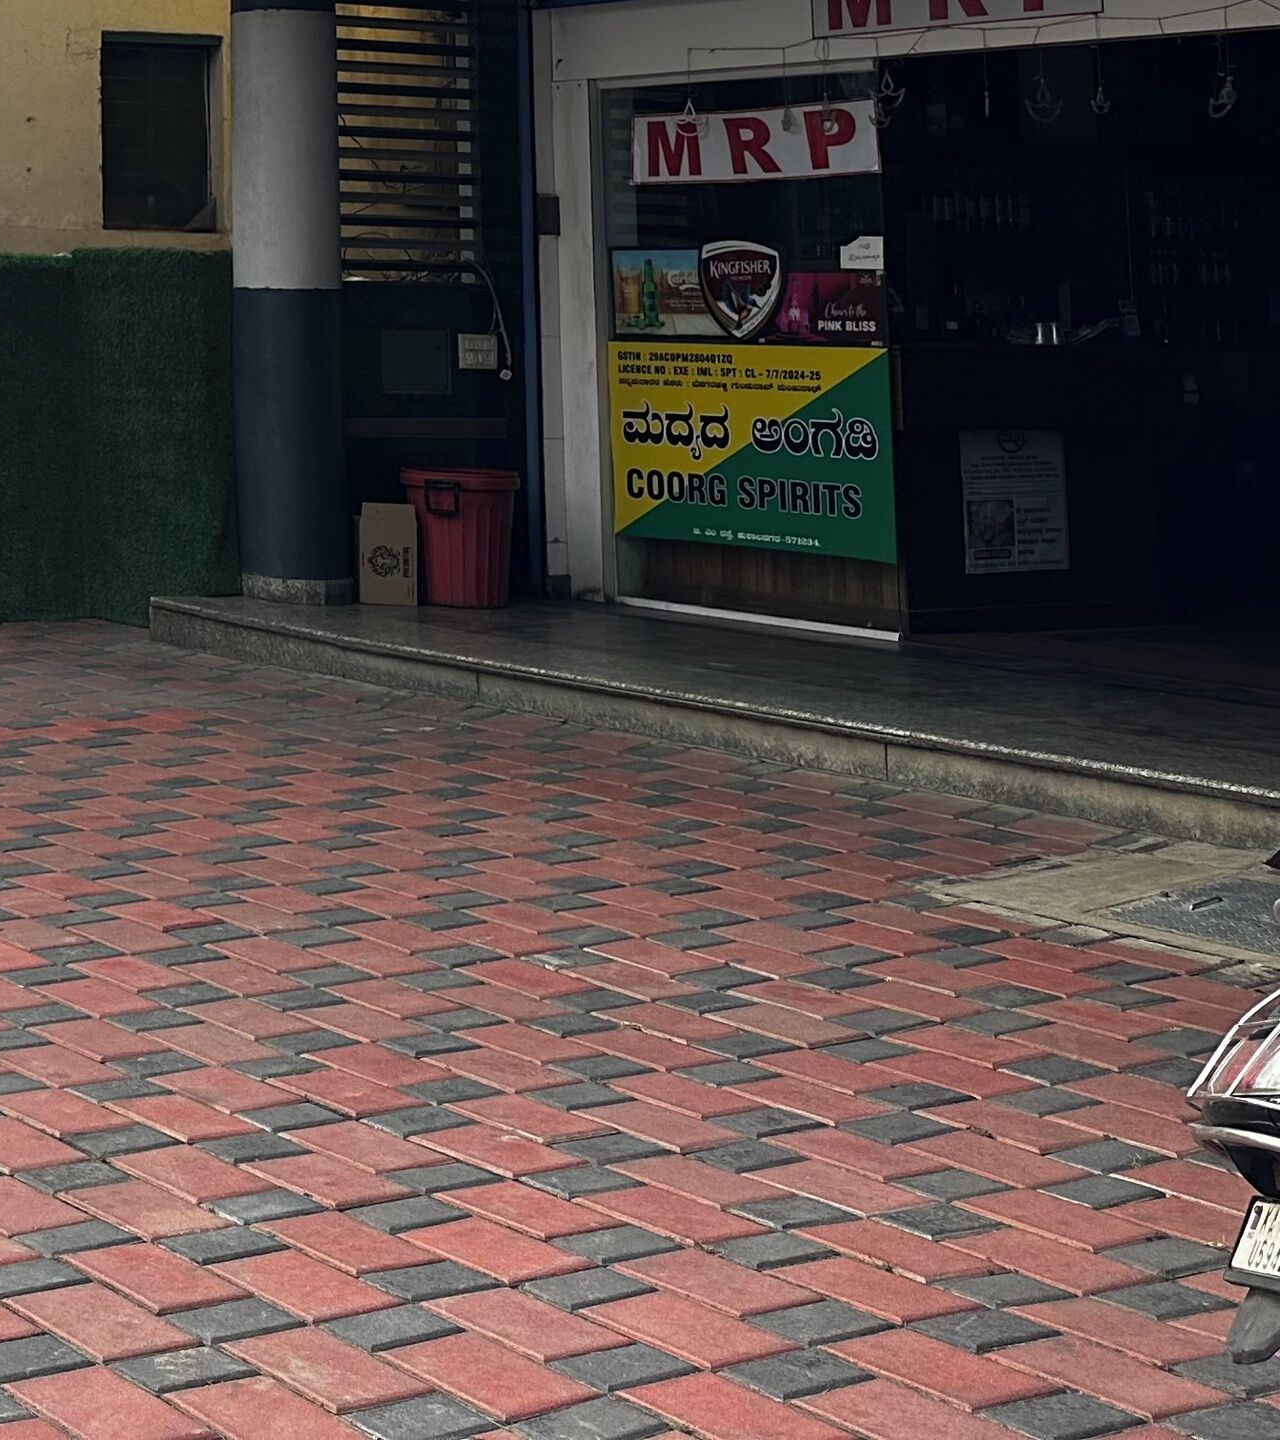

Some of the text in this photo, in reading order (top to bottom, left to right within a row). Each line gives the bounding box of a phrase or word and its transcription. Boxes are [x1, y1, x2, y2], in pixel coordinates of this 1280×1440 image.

[709, 259, 771, 279] KINGFISHER
[817, 320, 877, 332] PINK BLISS
[617, 351, 641, 361] GSTIN
[618, 364, 652, 374] LICENCE
[654, 365, 666, 375] NO
[673, 366, 689, 376] EXE
[697, 368, 712, 377] IML
[720, 368, 737, 377] SPT
[745, 368, 756, 378] CL
[765, 369, 821, 381] 7/7/2024-25
[622, 402, 880, 461] ಮದ್ಯದ ಅಂಗಡಿ
[625, 467, 863, 519] COORG SPIRITS
